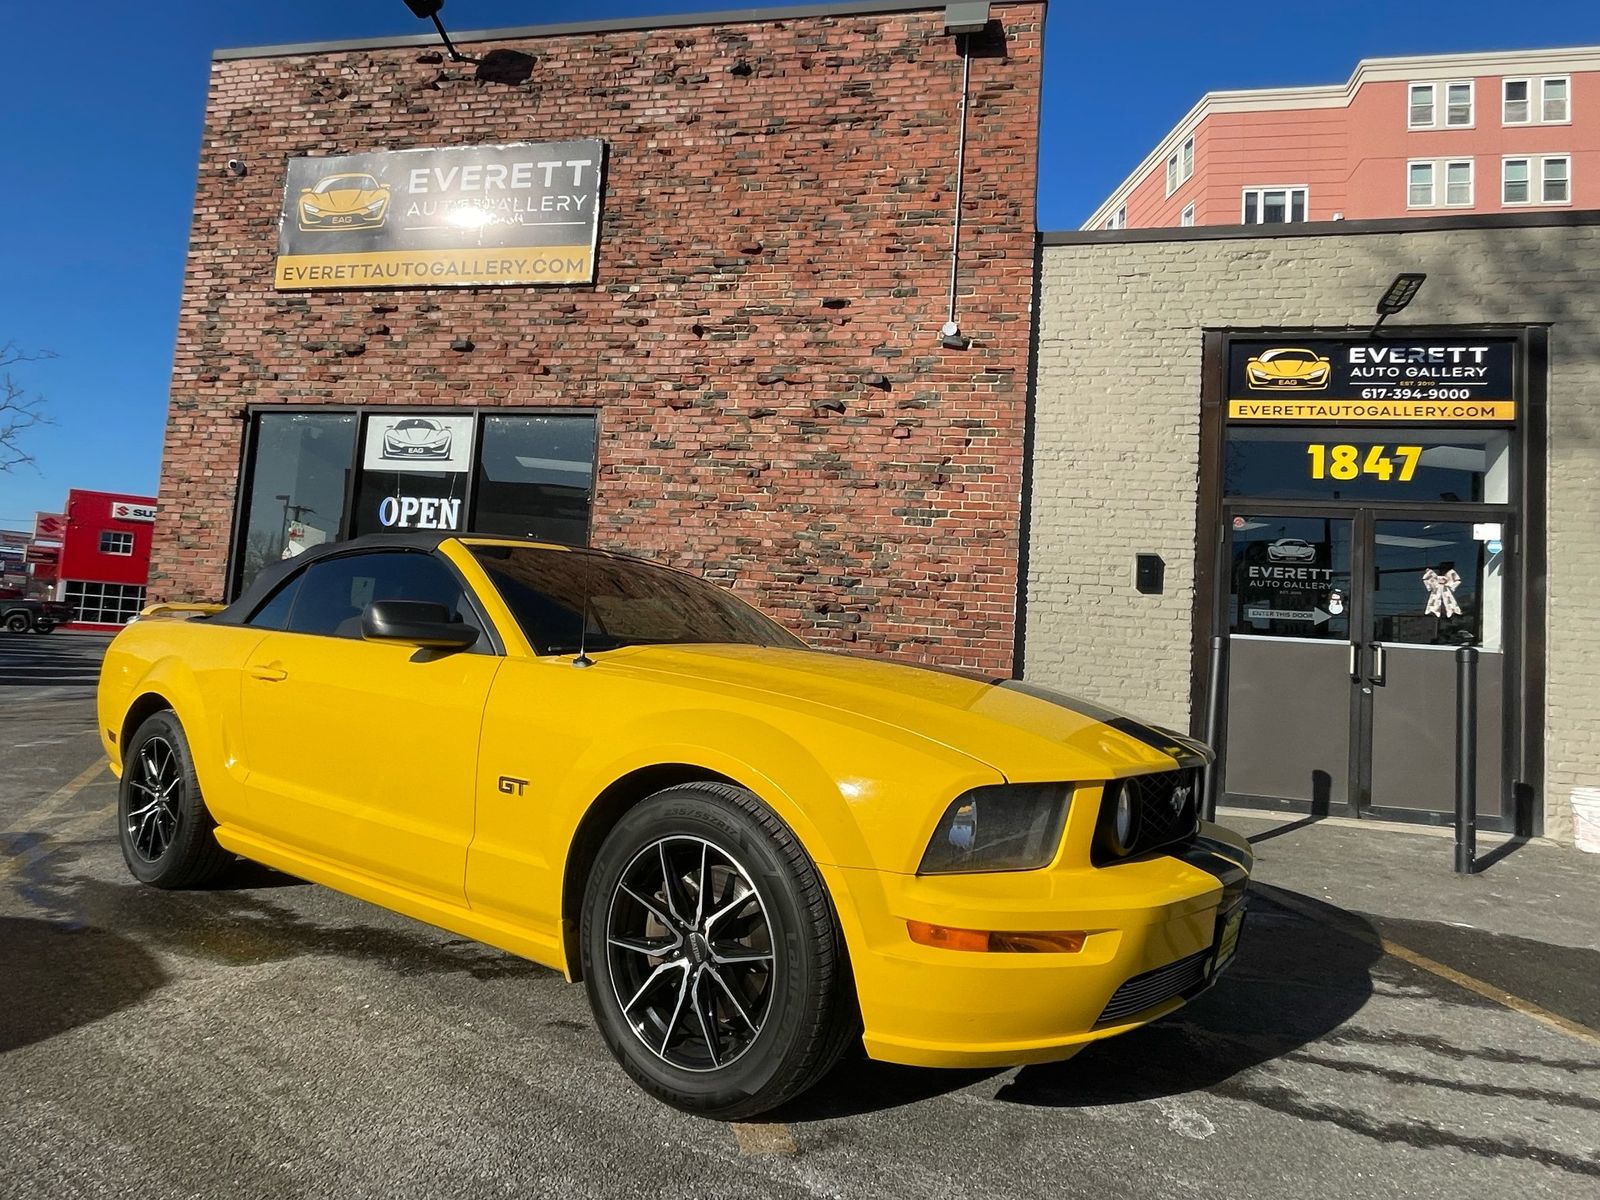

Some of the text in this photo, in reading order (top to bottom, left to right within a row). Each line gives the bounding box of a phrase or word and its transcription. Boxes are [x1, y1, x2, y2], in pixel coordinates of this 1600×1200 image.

[409, 160, 591, 193] EVERETT
[331, 215, 353, 225] EAG
[282, 257, 584, 281] EVERETTAUTOGALLERY.COM
[1349, 347, 1489, 364] EVERETT
[1350, 366, 1488, 378] AUTO GALLERY
[1361, 388, 1470, 400] 617-394-9000
[1238, 405, 1496, 417] EVERETTAUTOGALLERY.COM
[1307, 444, 1422, 482] 1847
[379, 496, 461, 530] OPEN
[1248, 566, 1334, 580] EVERETT
[1249, 580, 1333, 590] AUTO GALLERY
[498, 775, 529, 797] GT
